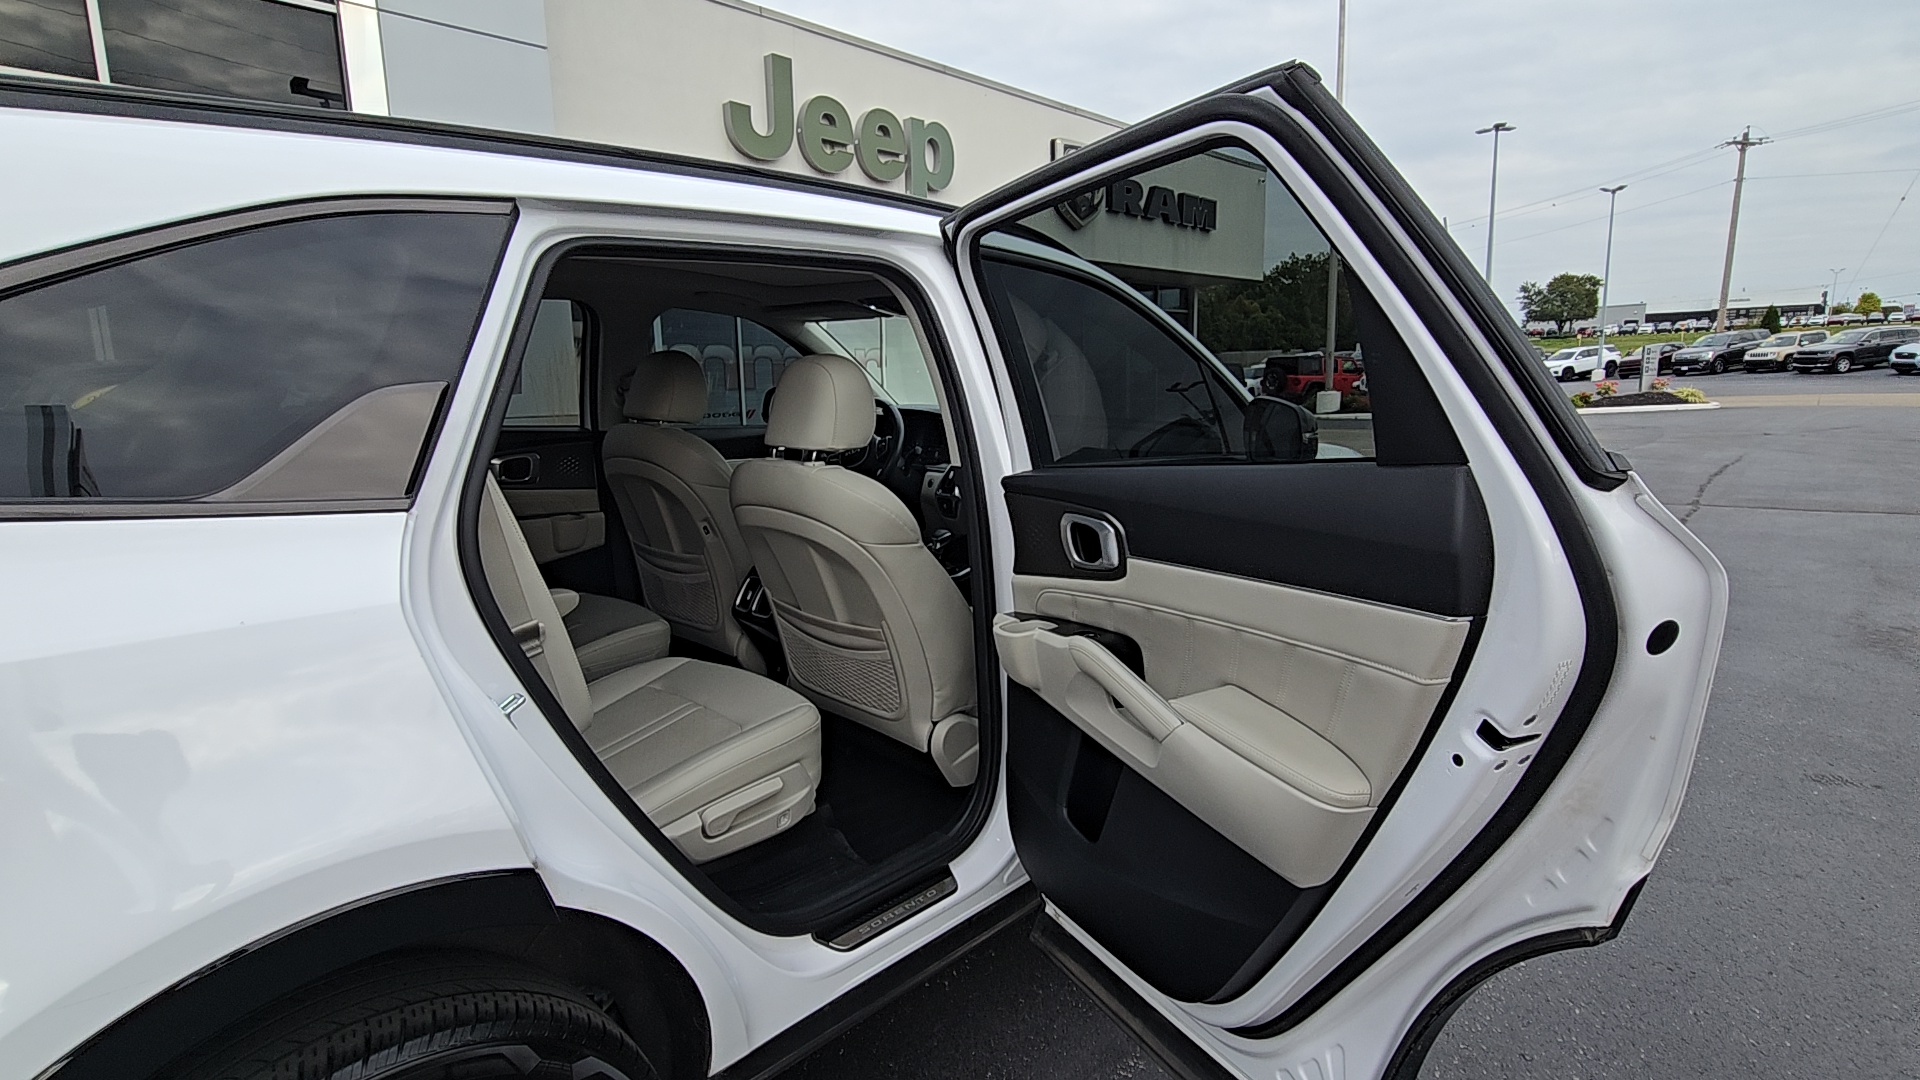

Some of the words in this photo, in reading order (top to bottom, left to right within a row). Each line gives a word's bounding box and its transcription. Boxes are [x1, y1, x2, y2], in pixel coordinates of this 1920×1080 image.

[723, 53, 955, 197] Jeep
[1106, 180, 1218, 231] RAM
[859, 890, 937, 934] SORENTO
